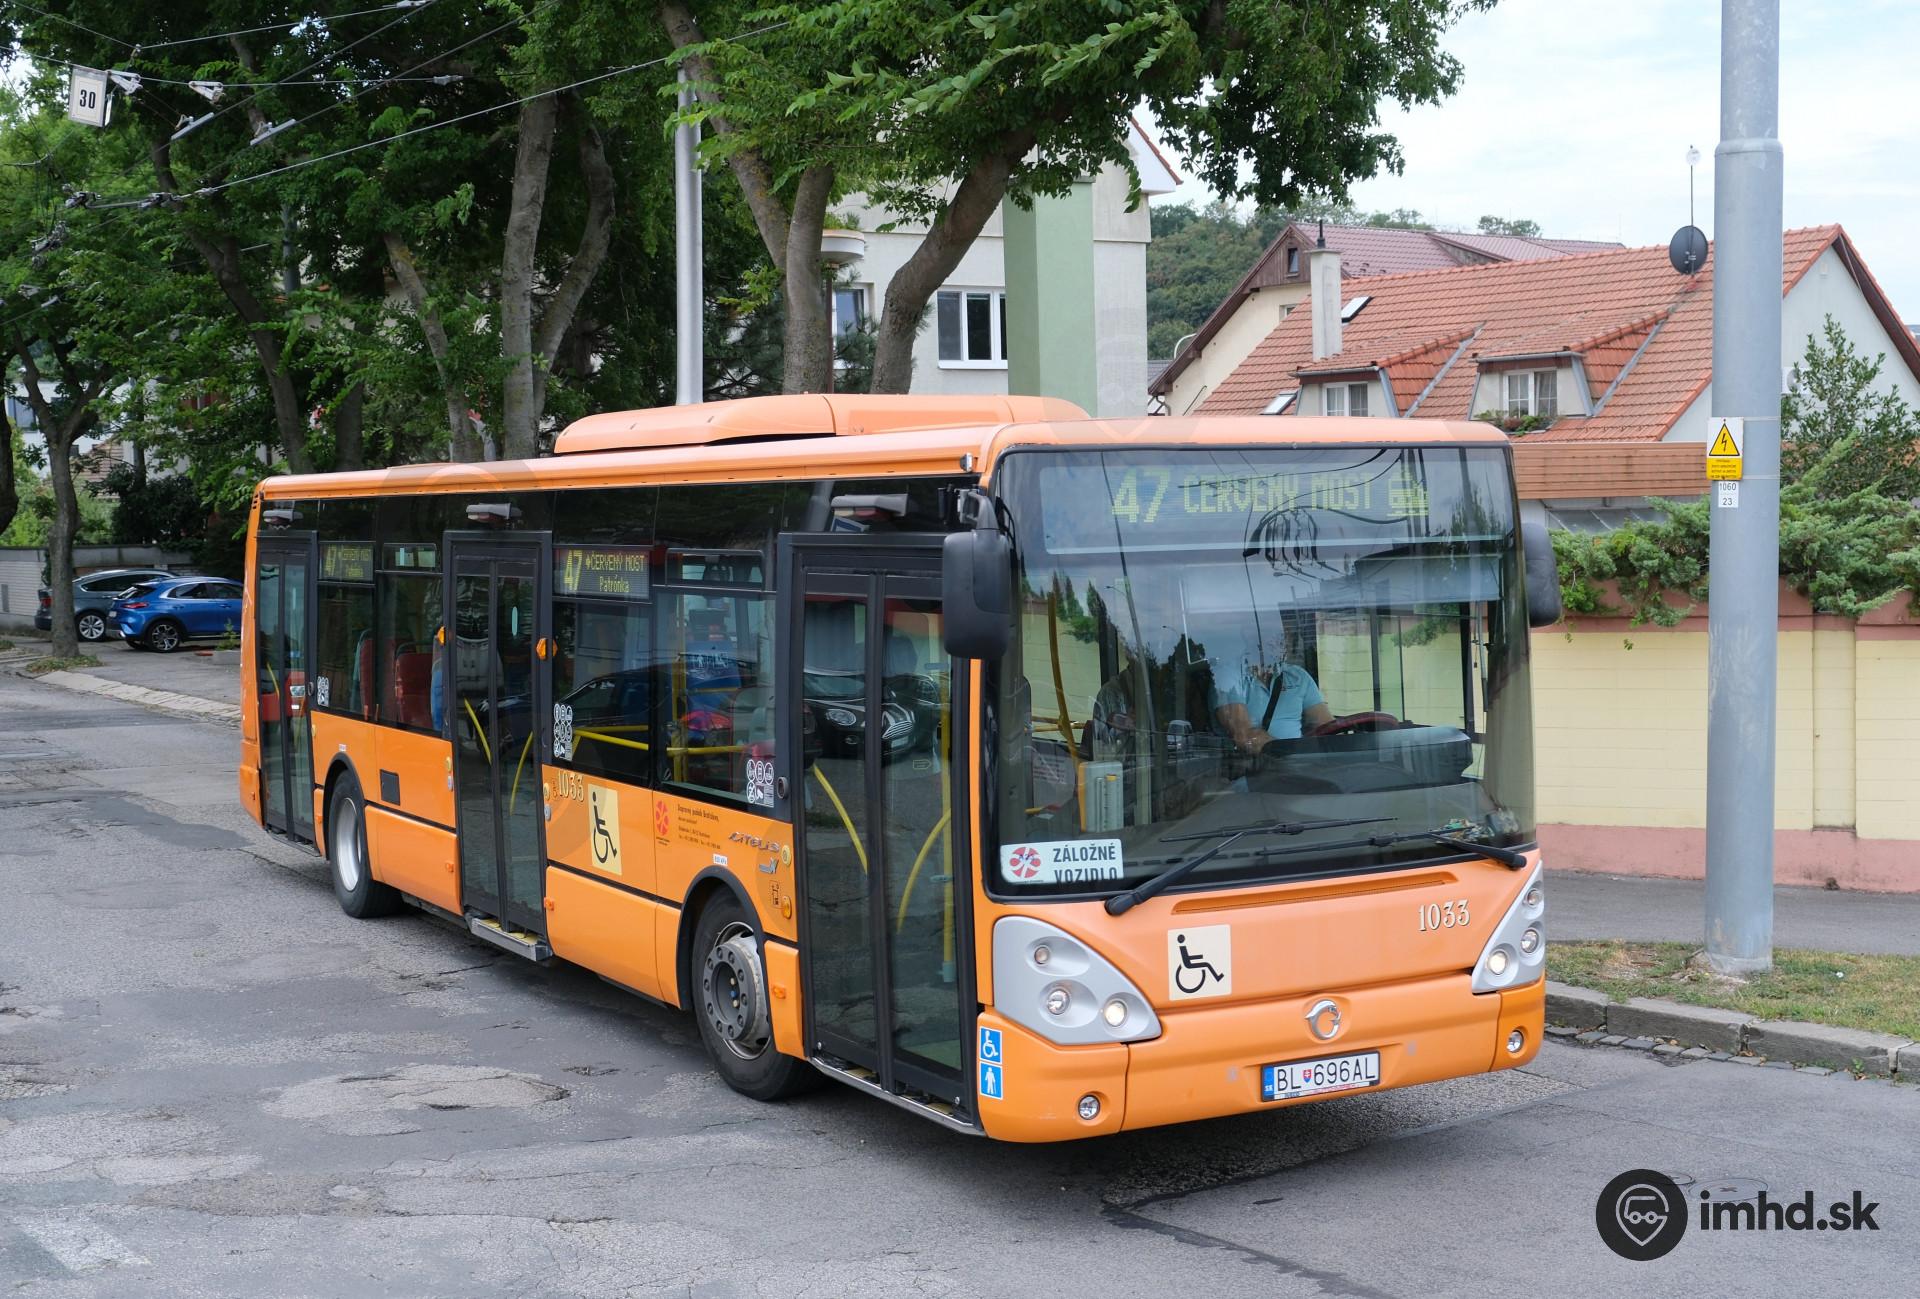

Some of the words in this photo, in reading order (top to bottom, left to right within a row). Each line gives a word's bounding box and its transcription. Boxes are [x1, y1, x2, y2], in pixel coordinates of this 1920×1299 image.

[80, 89, 96, 109] 30
[1111, 466, 1171, 523] 47
[1311, 472, 1377, 511] MOST
[1719, 482, 1737, 491] 1060
[1722, 497, 1733, 506] 23
[563, 549, 583, 592] 47
[591, 550, 624, 571] ČERVENÝ
[625, 554, 645, 572] MOST
[599, 574, 630, 593] Patrónka
[559, 769, 584, 802] 1033
[1052, 842, 1117, 863] ZÁLOŽNÉ
[1418, 899, 1471, 931] 1033
[1277, 1066, 1302, 1092] BL
[1313, 1057, 1376, 1086] 696AL
